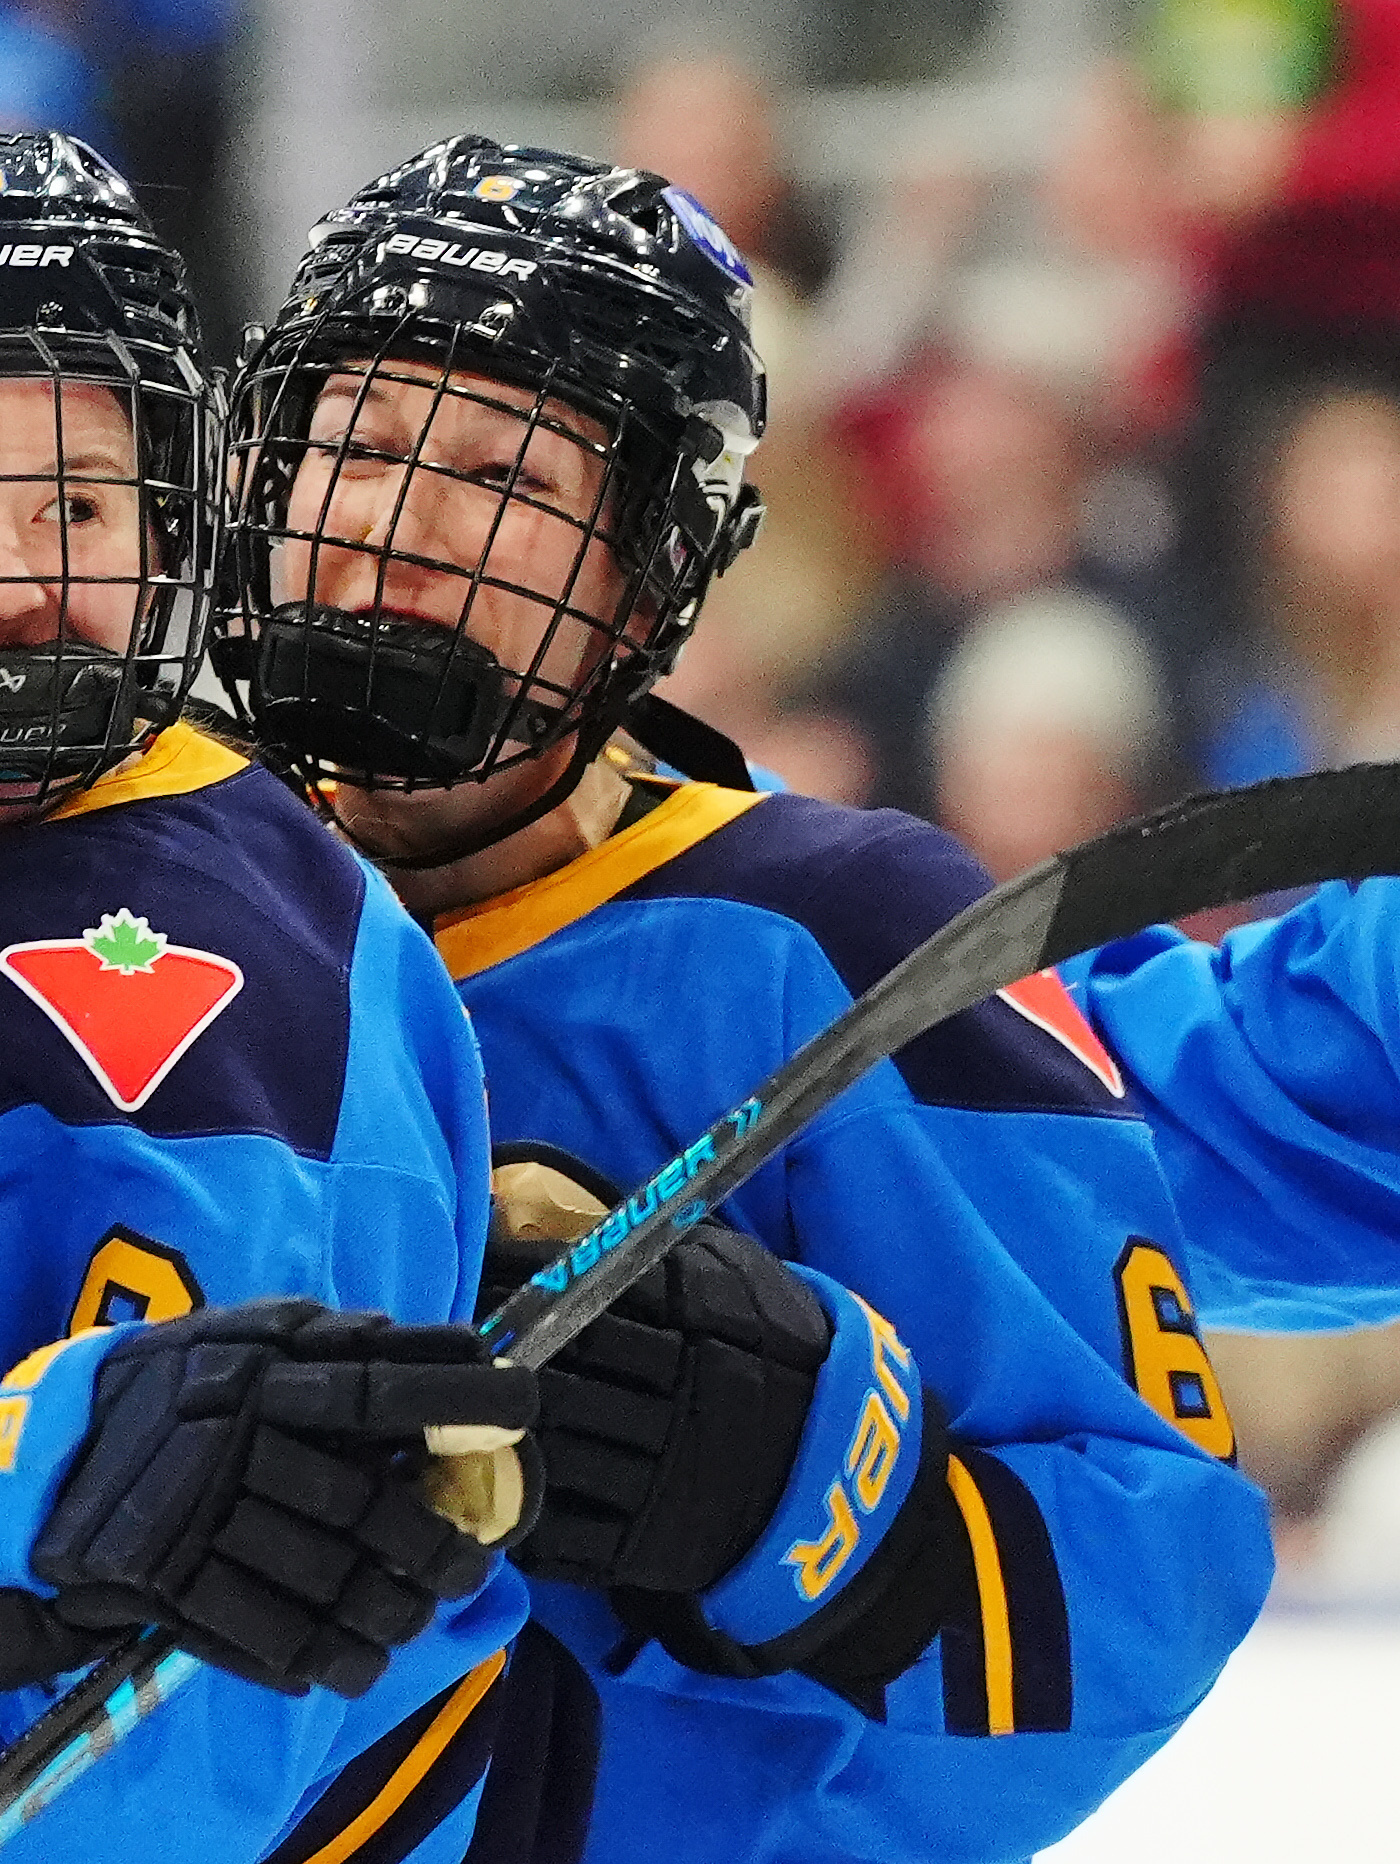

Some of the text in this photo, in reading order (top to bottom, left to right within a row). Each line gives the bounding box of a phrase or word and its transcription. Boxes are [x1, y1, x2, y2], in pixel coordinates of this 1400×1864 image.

[385, 232, 538, 282] BAUER
[570, 1134, 716, 1277] BAUER
[1113, 1236, 1237, 1466] 6
[780, 1292, 911, 1602] UER
